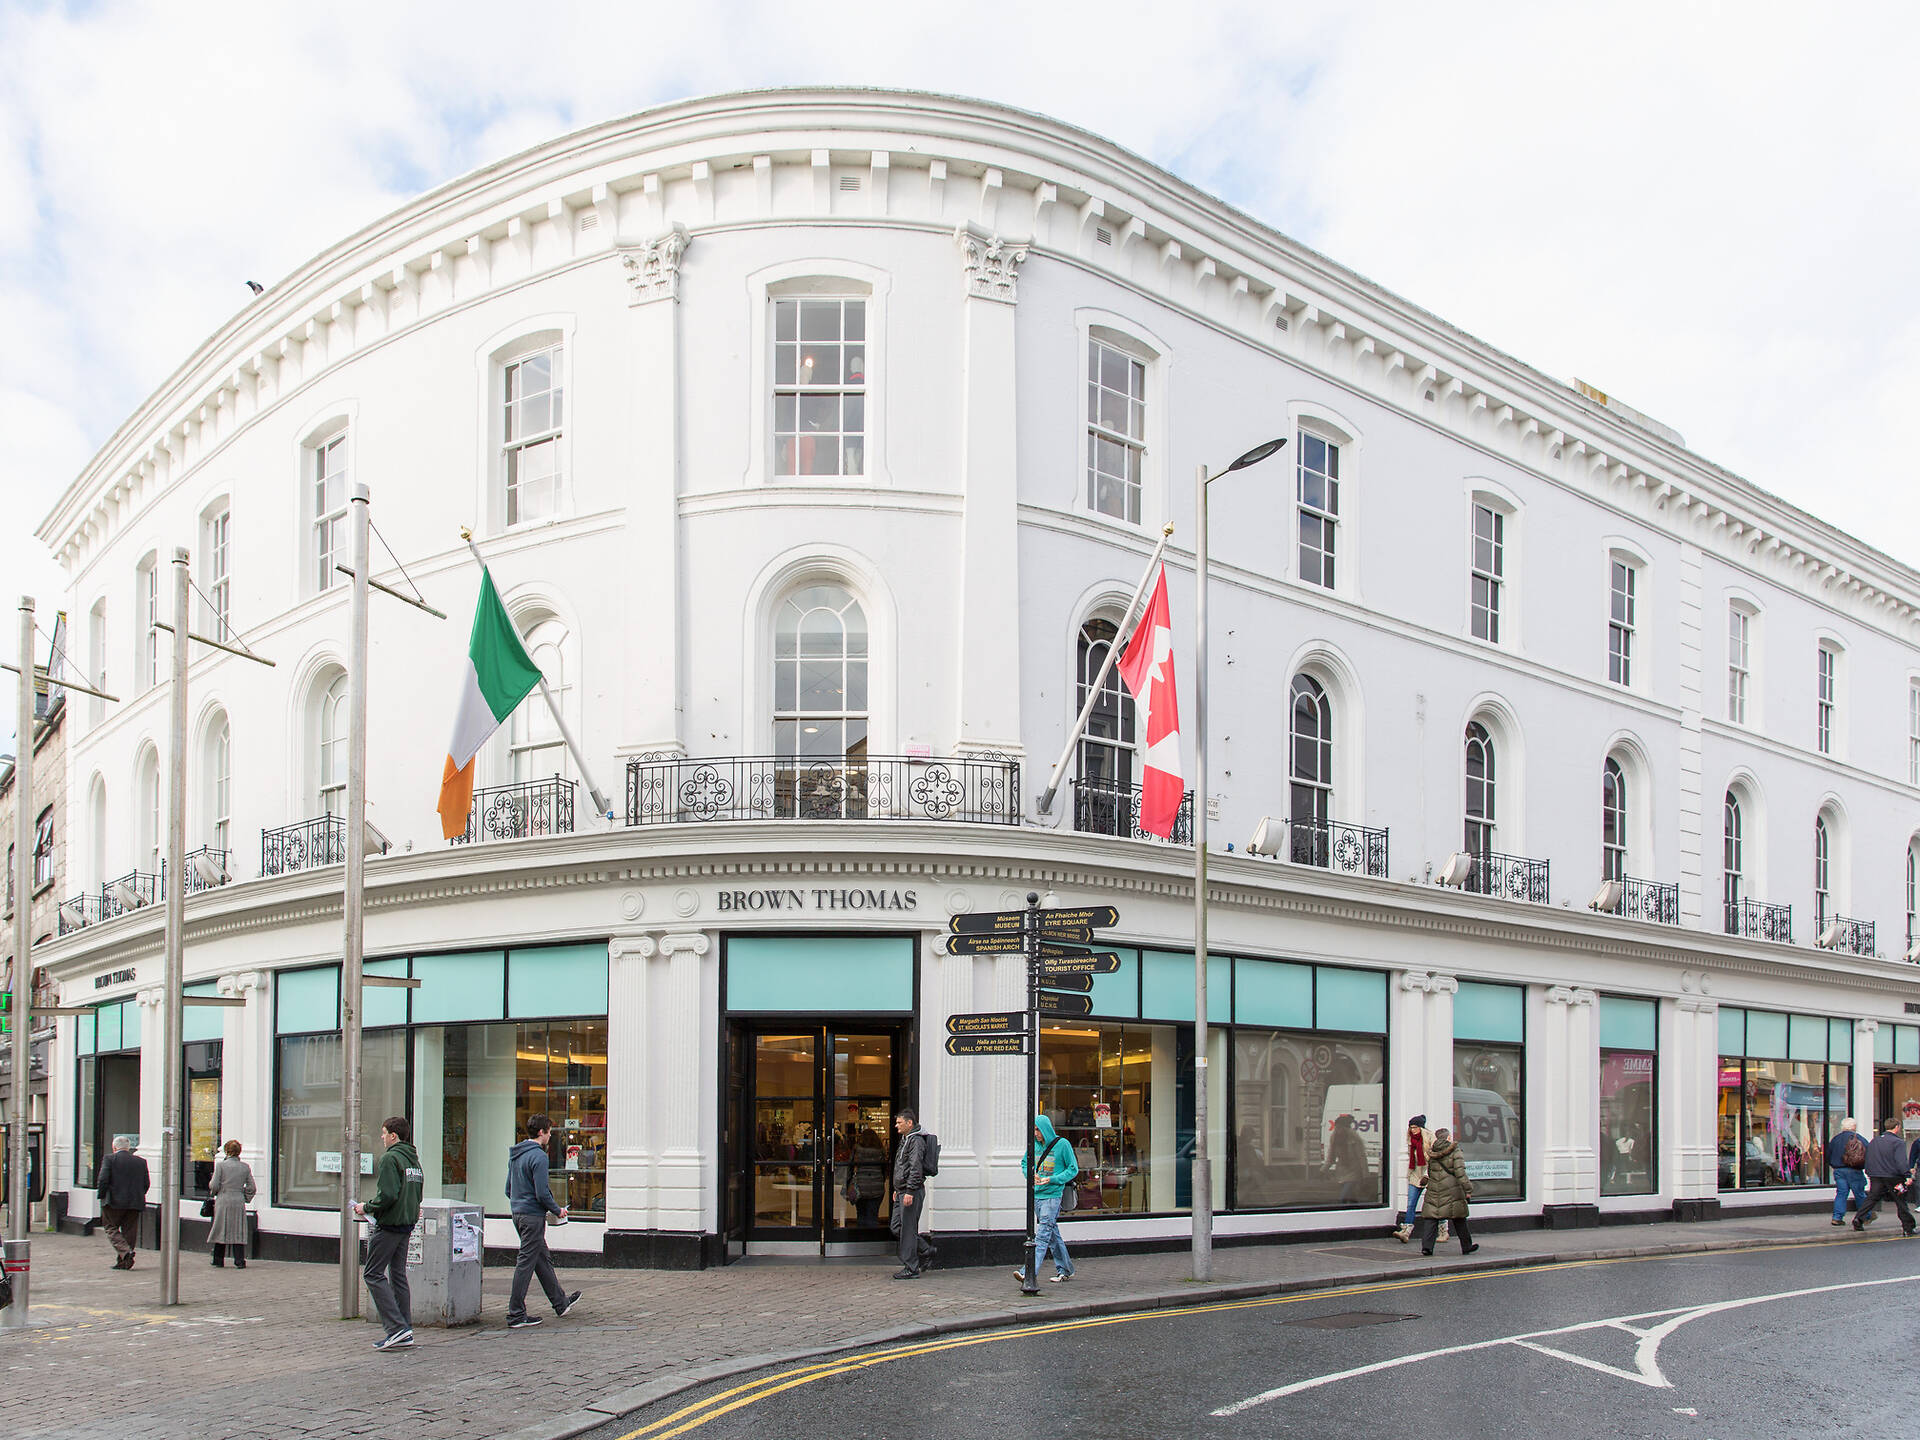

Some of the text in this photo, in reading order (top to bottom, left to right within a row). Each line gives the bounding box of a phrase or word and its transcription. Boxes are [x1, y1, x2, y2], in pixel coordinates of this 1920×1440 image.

[717, 889, 917, 911] BROWN THOMAS
[1062, 918, 1088, 926] SQUARE
